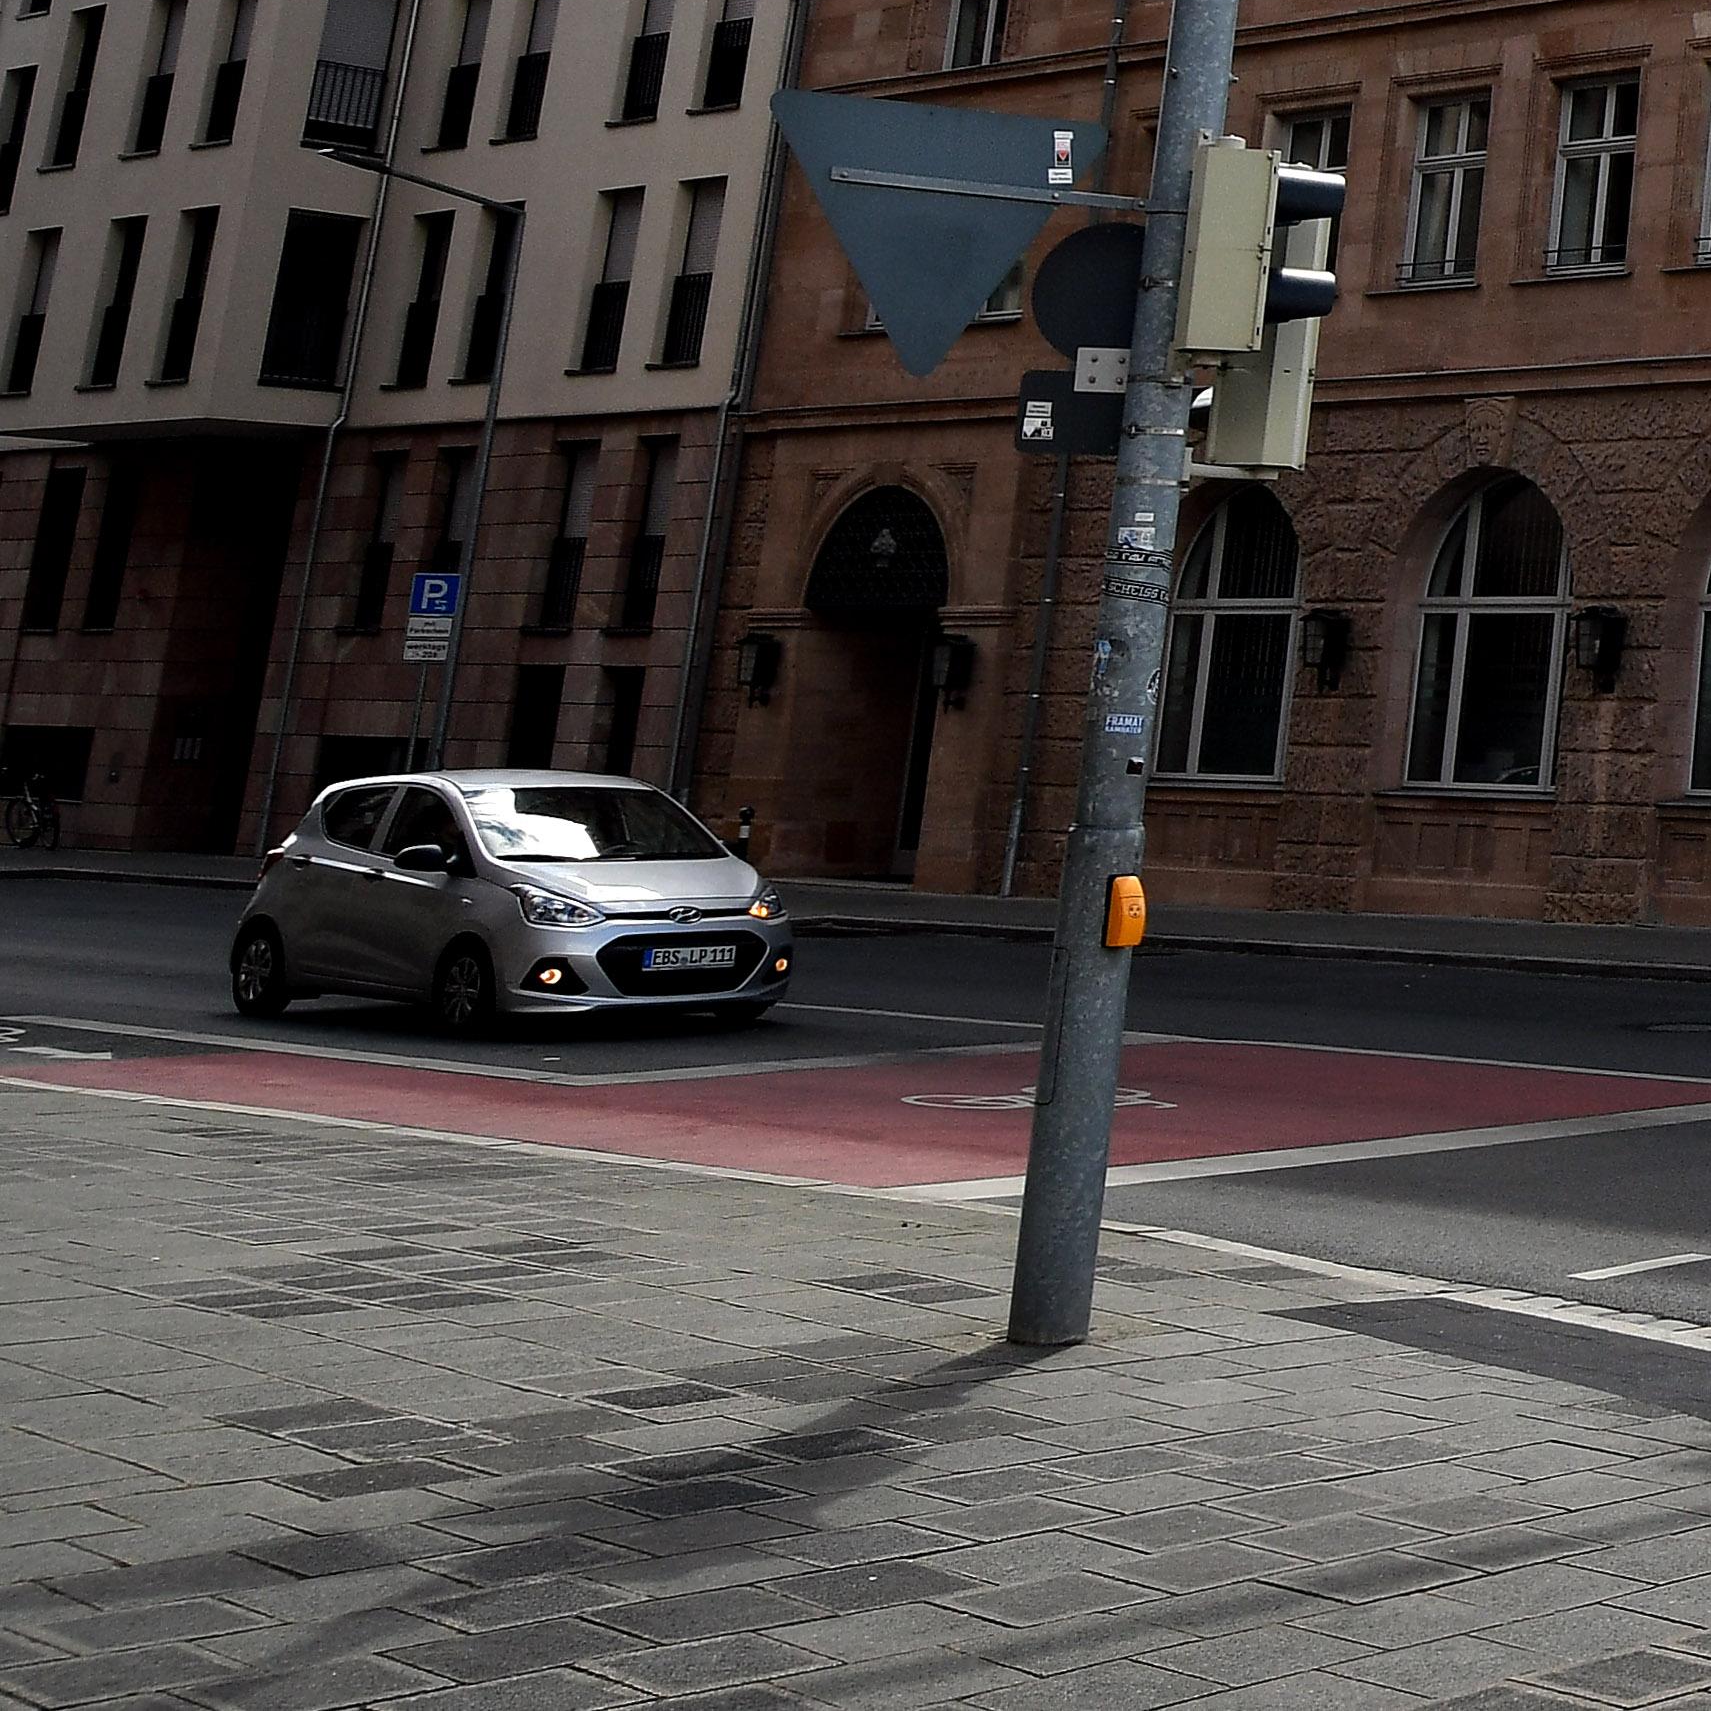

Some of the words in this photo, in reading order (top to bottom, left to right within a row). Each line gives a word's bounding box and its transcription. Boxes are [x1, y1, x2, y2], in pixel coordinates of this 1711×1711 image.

[421, 579, 448, 609] P
[1108, 582, 1159, 599] SCHEISS
[653, 950, 680, 965] EBS
[710, 948, 734, 962] 111
